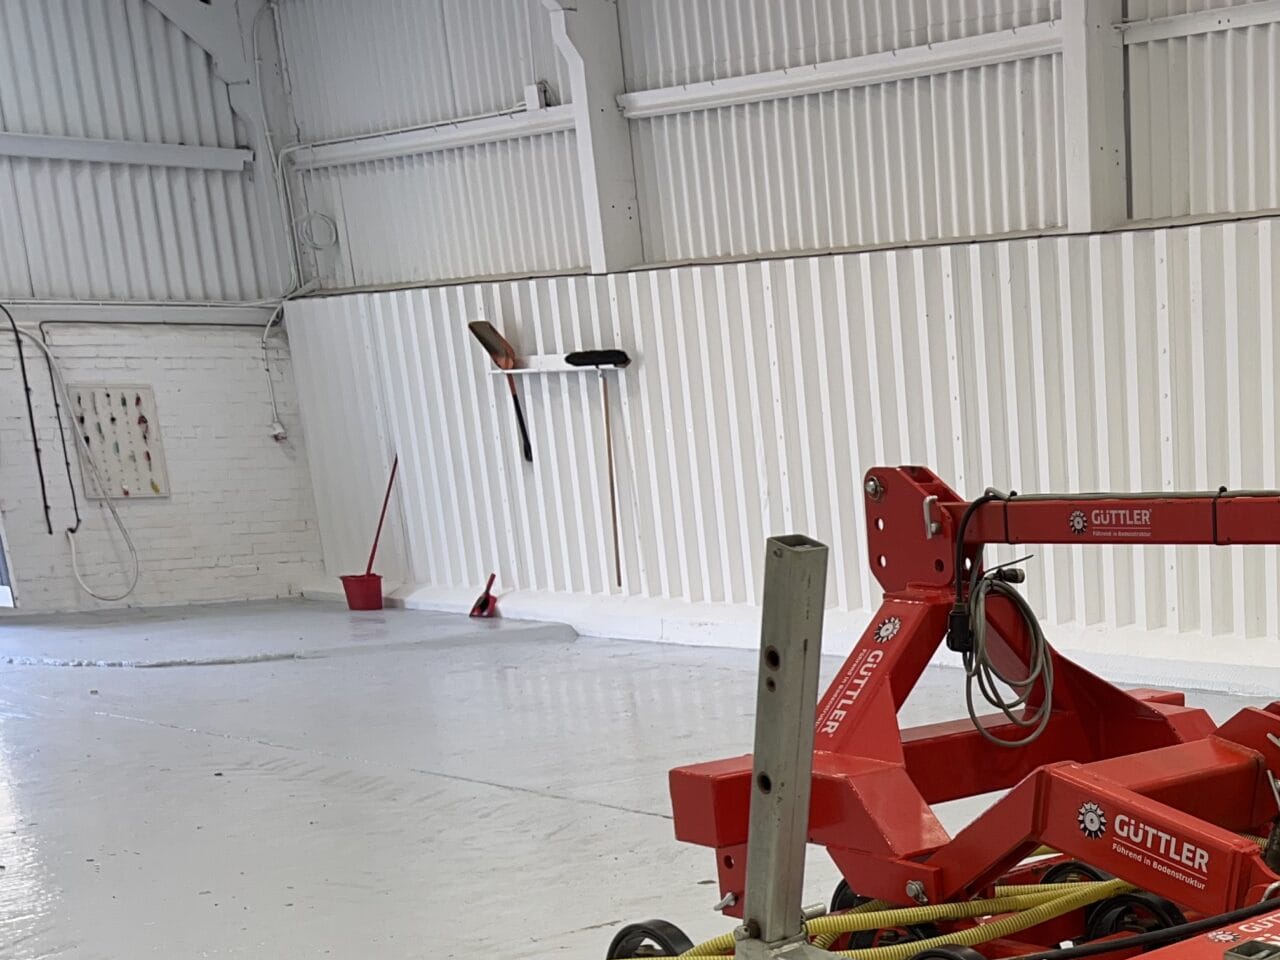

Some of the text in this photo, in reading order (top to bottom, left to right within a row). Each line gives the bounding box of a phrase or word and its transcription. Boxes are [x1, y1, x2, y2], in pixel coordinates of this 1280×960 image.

[1091, 509, 1151, 525] GÜTTLER
[821, 650, 884, 734] GÜTTLER
[1112, 843, 1206, 890] Führend in Bodenstruktur
[1114, 814, 1209, 873] GÜTTLER
